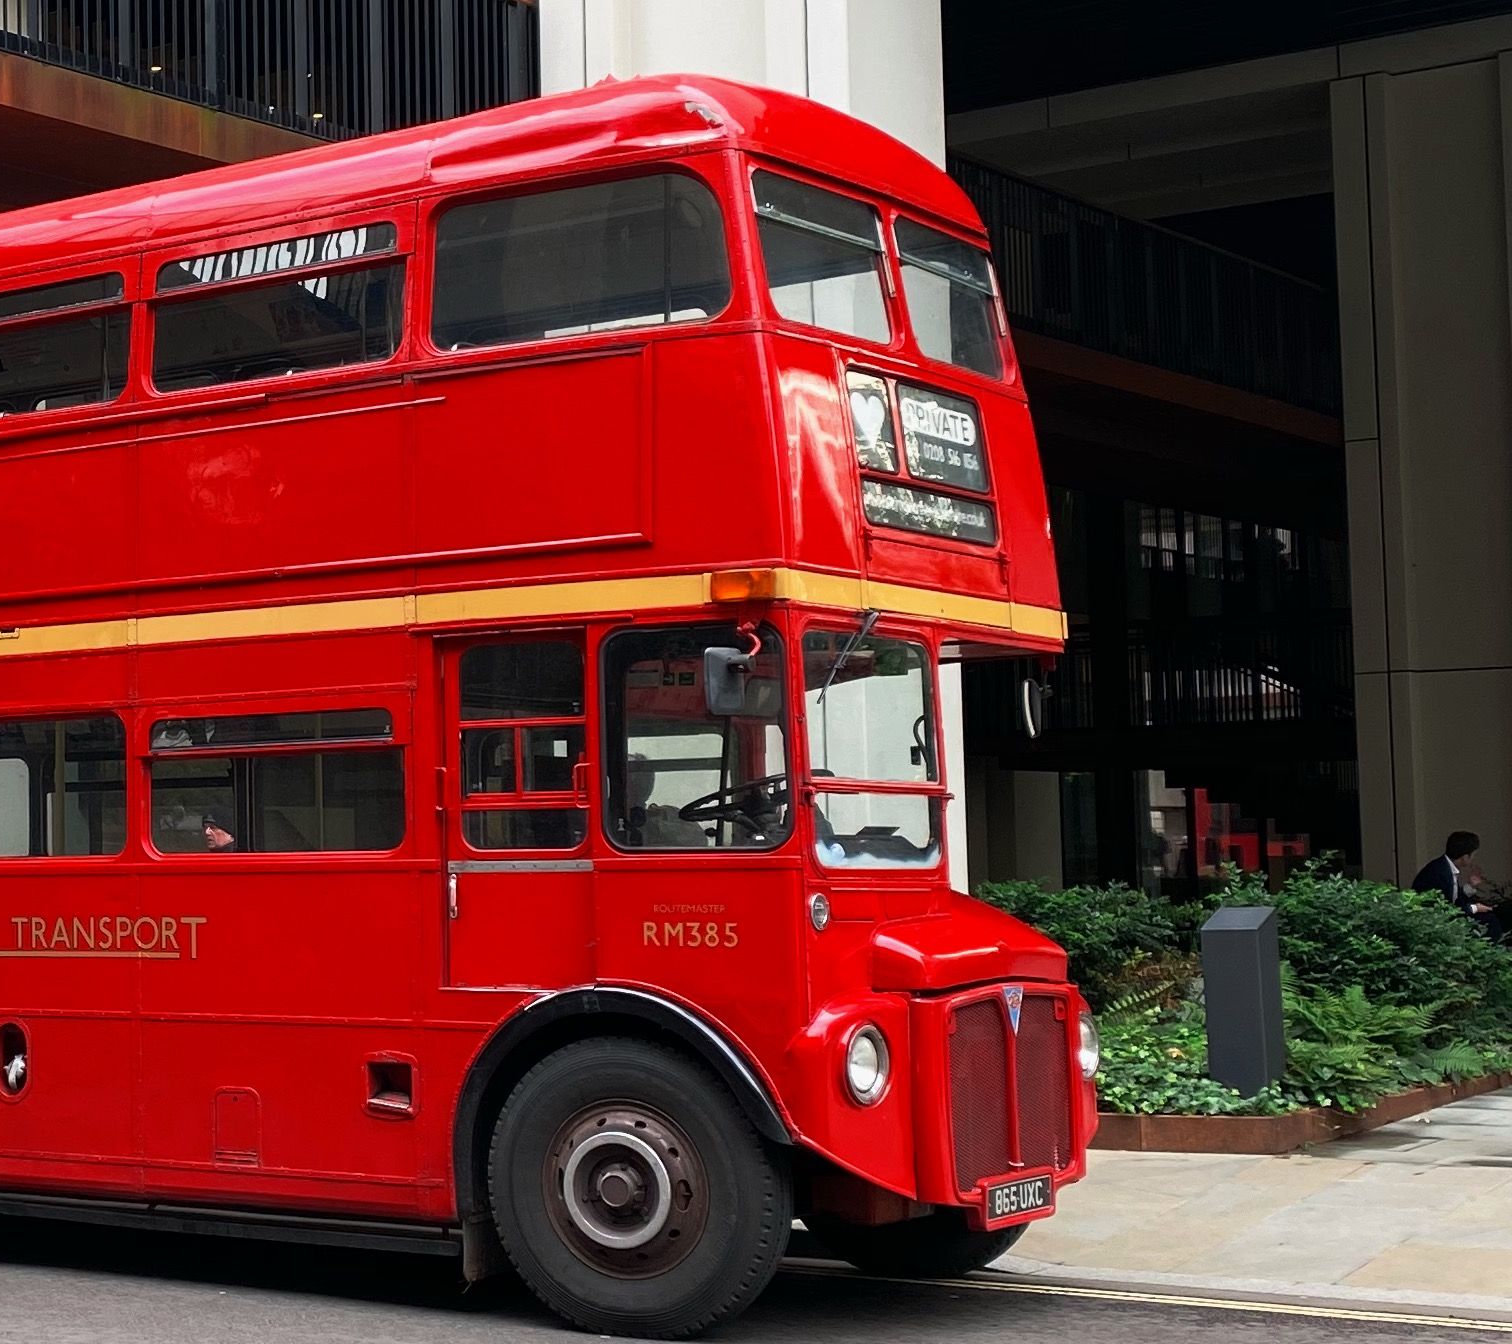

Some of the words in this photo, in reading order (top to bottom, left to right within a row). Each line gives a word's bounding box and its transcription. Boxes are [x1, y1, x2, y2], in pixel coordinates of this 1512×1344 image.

[905, 402, 970, 443] PRIVATE
[653, 903, 726, 914] ROUTEMASTER
[11, 916, 208, 959] TRANSPORT
[642, 921, 739, 948] RM385
